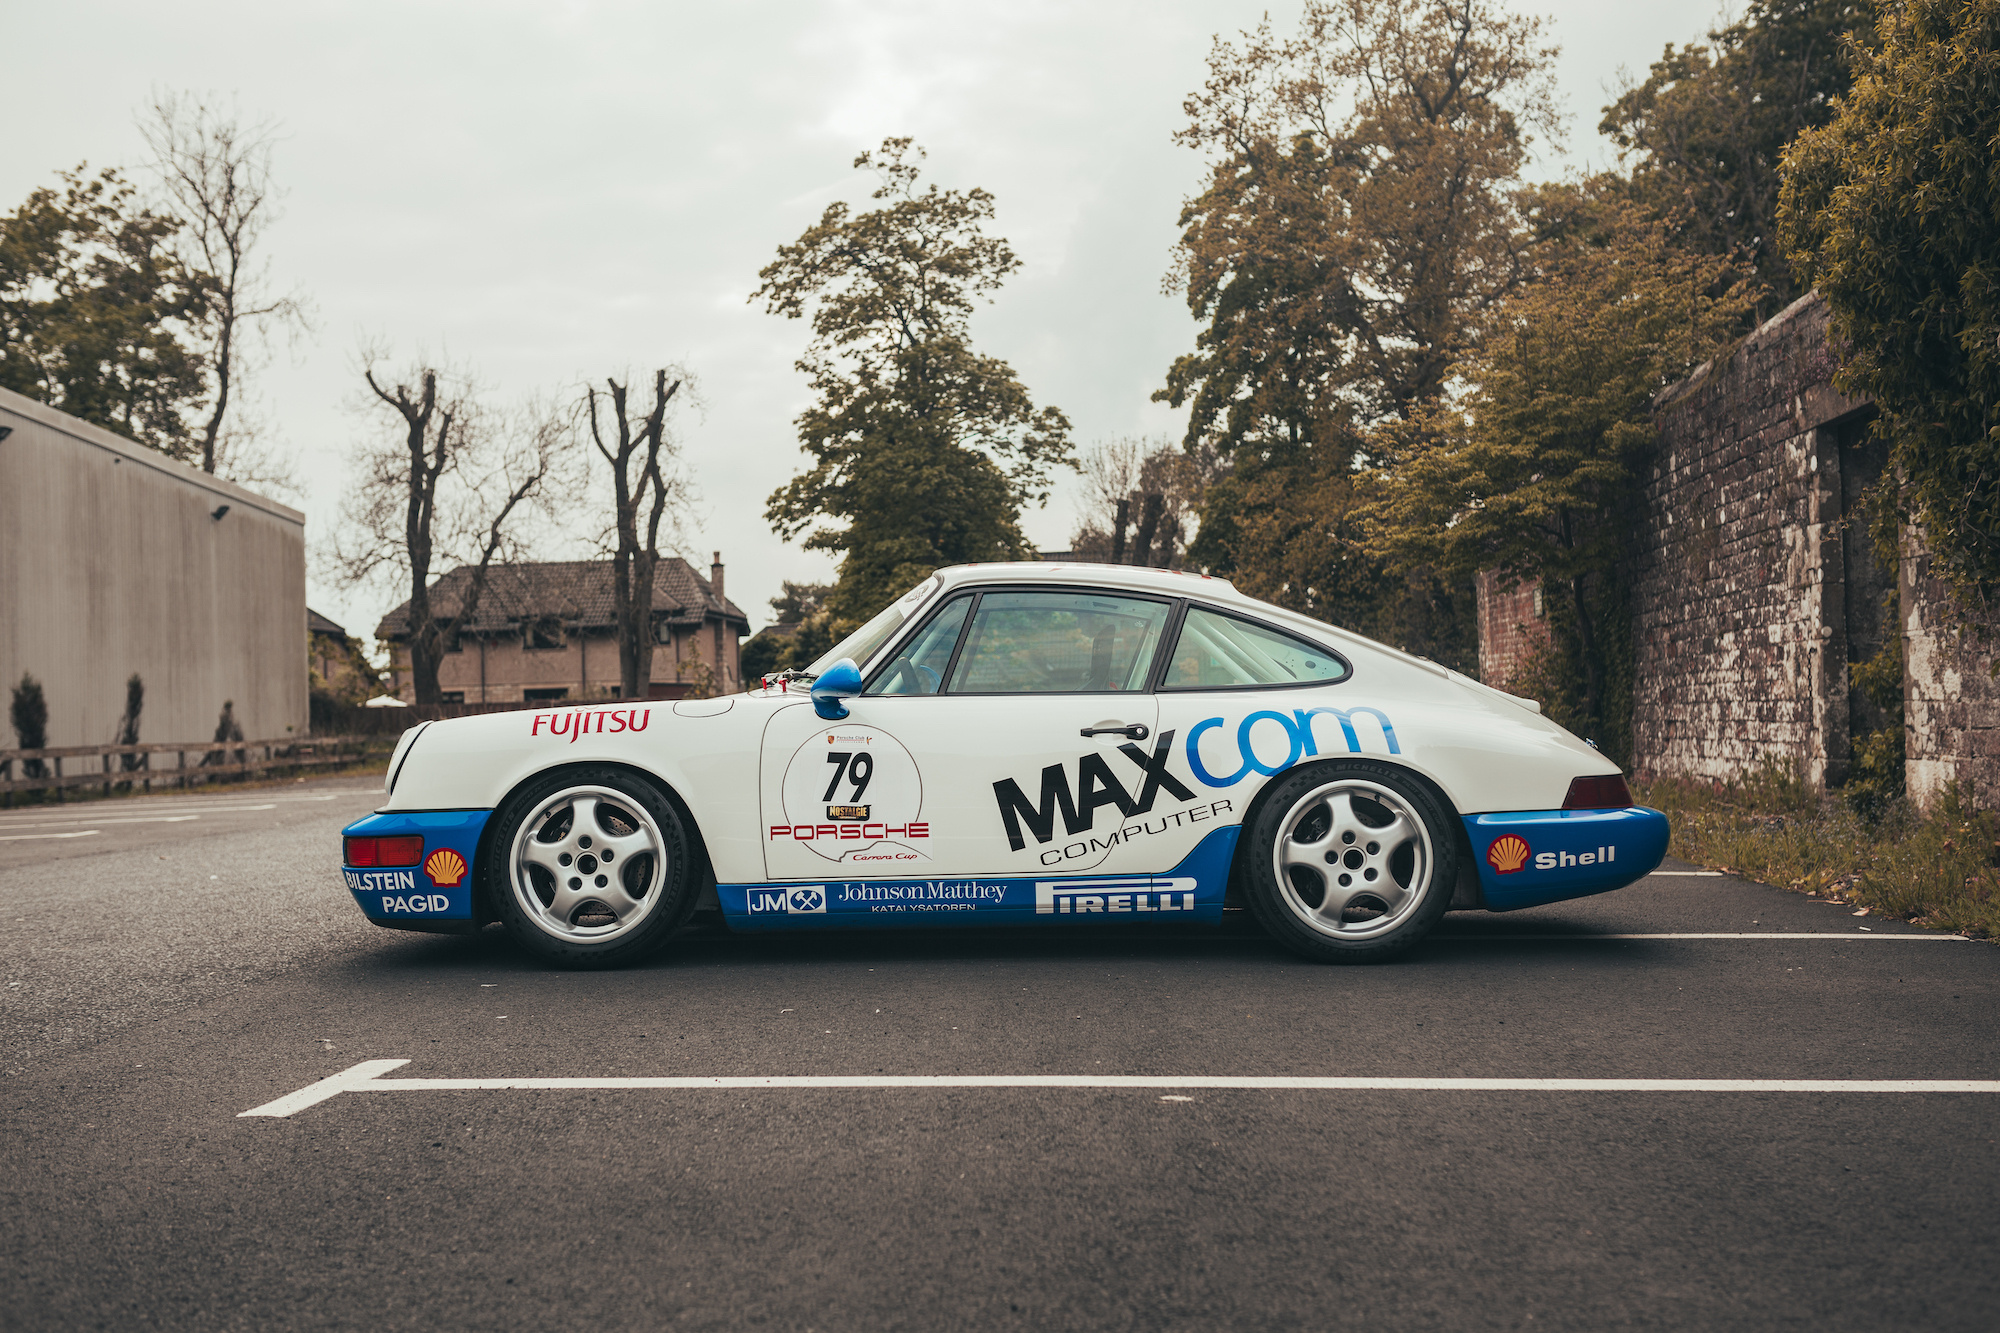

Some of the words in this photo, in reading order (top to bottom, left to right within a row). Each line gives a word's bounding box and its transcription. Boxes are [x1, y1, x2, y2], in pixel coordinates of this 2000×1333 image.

[531, 709, 651, 744] FUJITSU
[822, 752, 873, 803] 79
[1336, 763, 1399, 780] MICHELIN
[494, 812, 515, 870] MICHELIN
[770, 823, 929, 841] PORSCHE
[1040, 799, 1233, 866] COMPUTER
[895, 852, 918, 860] Cup
[1535, 846, 1615, 870] Shell
[345, 871, 415, 891] BILSTEIN
[661, 859, 681, 918] MICHELIN
[838, 883, 924, 901] Johnson
[927, 881, 1008, 903] Matthey
[382, 894, 449, 913] PAGID
[751, 893, 787, 912] JM
[1035, 877, 1198, 914] PIRELLI
